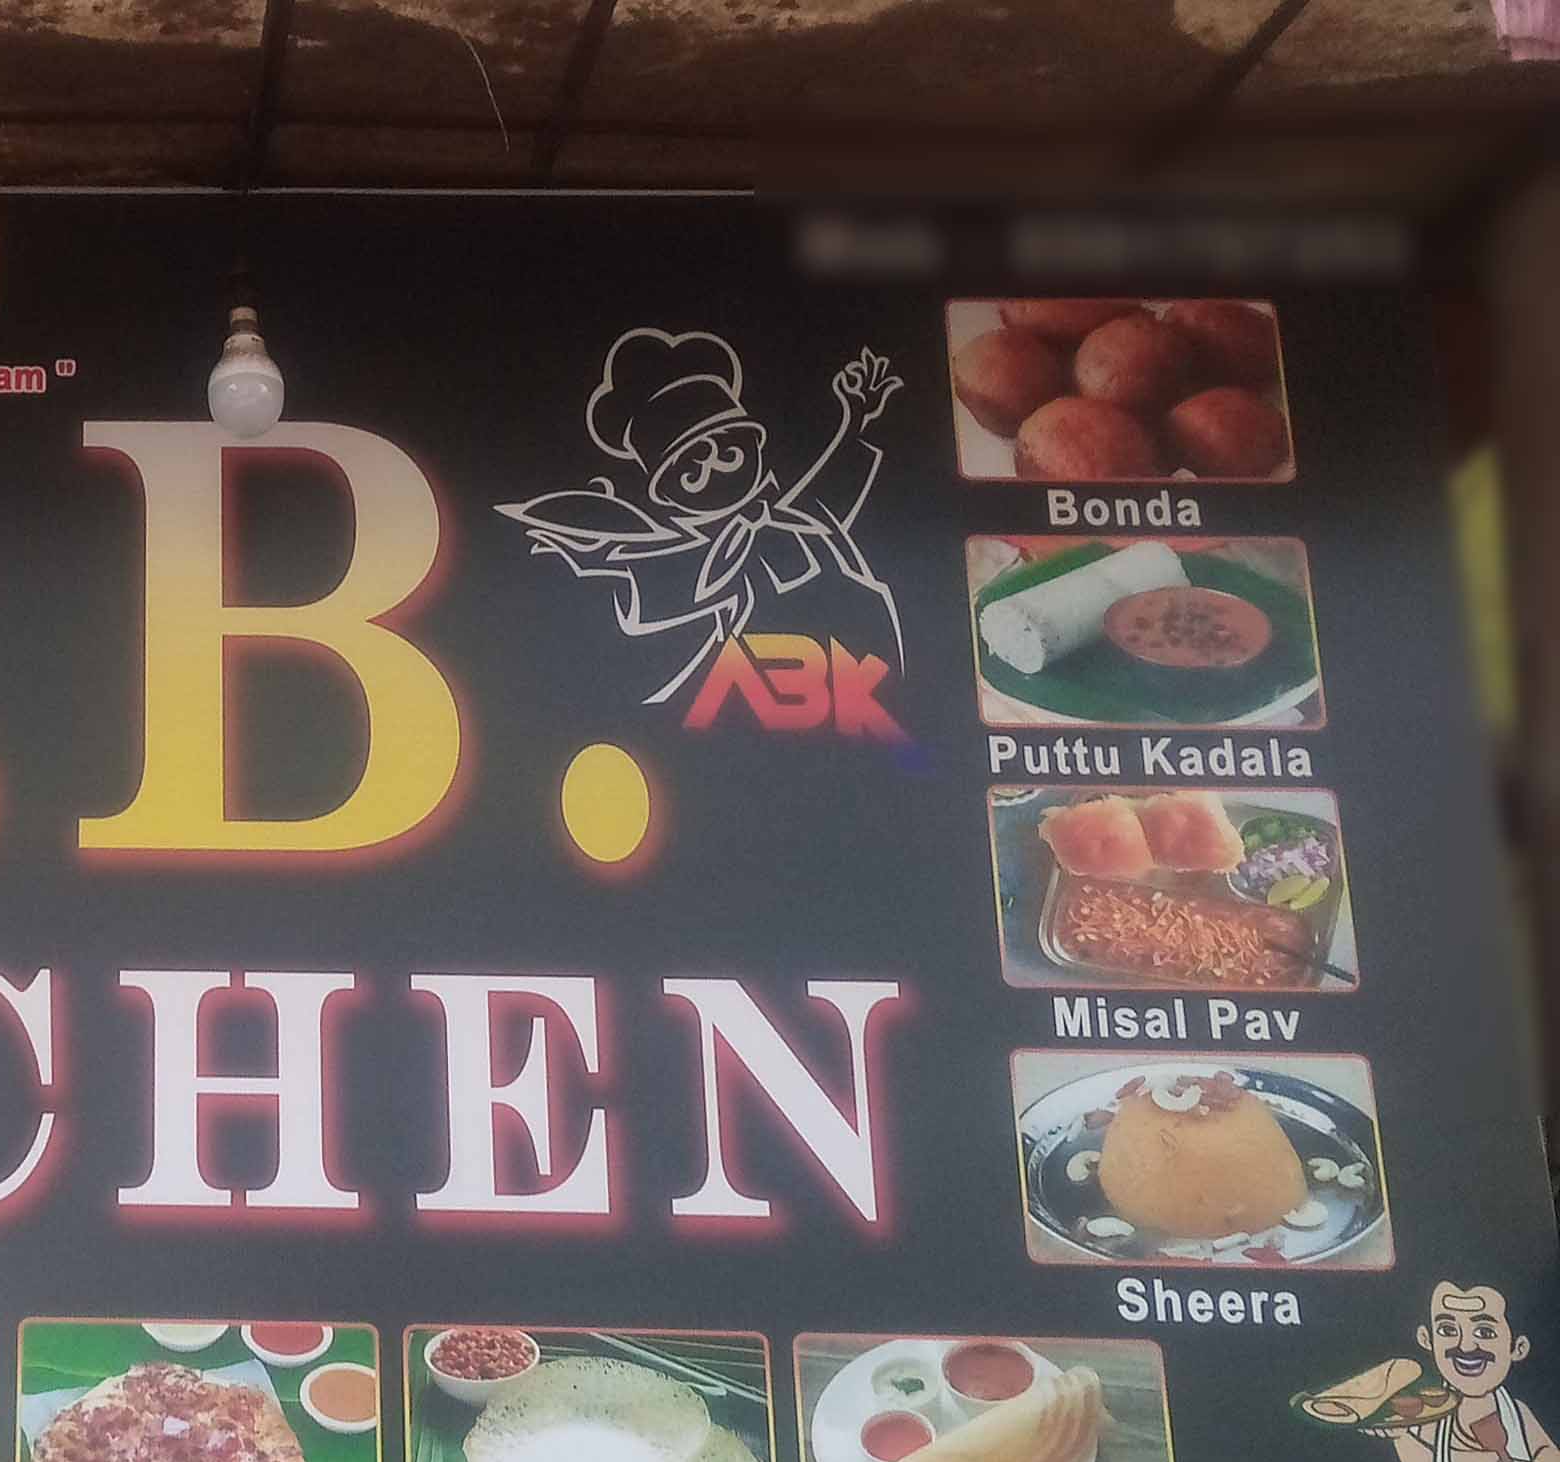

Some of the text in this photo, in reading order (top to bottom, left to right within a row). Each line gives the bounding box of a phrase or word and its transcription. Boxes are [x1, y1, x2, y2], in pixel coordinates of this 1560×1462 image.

[1047, 489, 1202, 527] Bonda
[988, 735, 1313, 777] Puttu Kadala
[1053, 996, 1300, 1041] Misal Pav
[1117, 1277, 1301, 1325] Sheera
